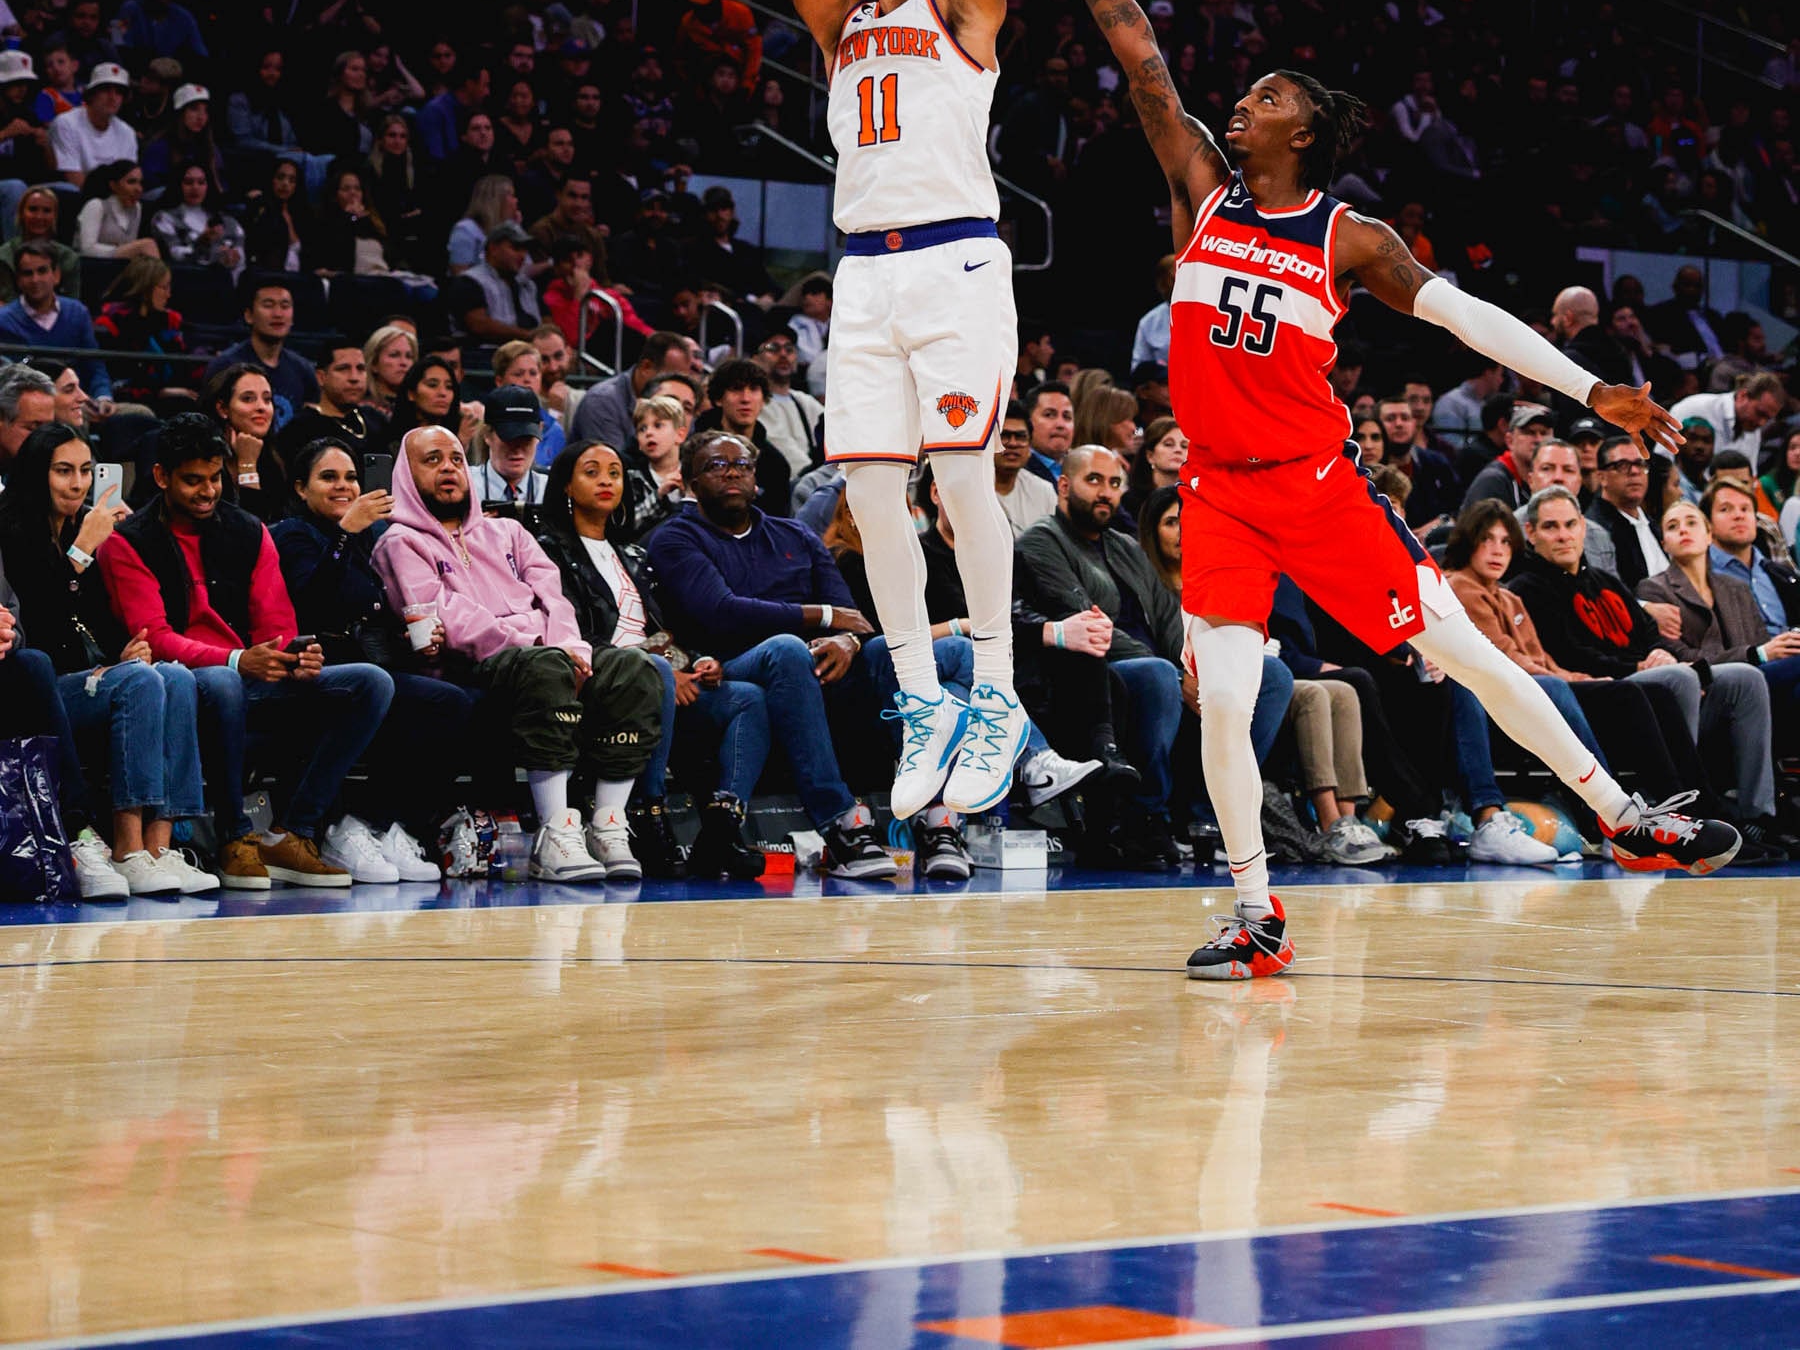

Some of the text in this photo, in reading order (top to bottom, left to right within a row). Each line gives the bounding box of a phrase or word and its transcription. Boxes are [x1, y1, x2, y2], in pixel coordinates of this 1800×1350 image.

[871, 26, 941, 61] YORK
[857, 73, 901, 148] 11
[1200, 236, 1326, 284] washington
[1210, 275, 1284, 357] 55
